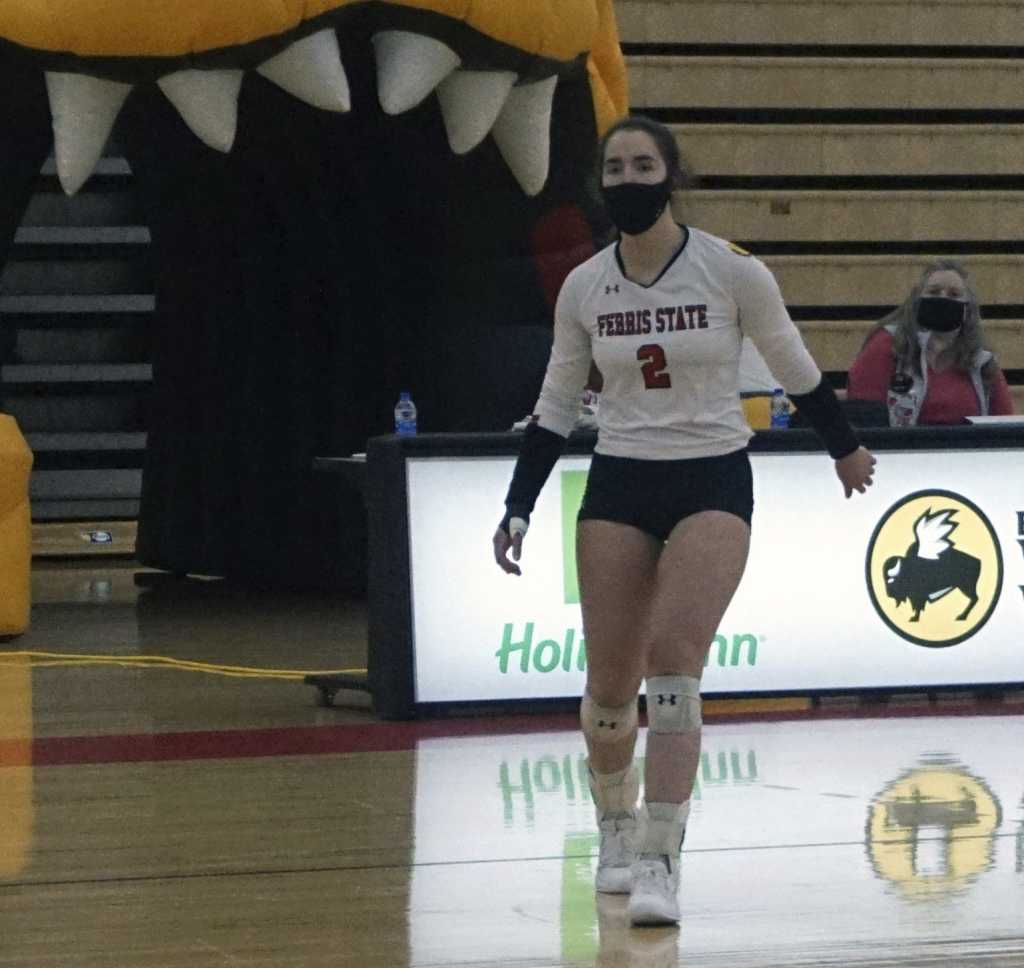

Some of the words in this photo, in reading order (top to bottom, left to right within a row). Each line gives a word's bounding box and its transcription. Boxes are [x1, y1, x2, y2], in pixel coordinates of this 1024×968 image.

[596, 308, 652, 338] FERRIS
[656, 303, 709, 334] STATE
[636, 343, 673, 390] 2
